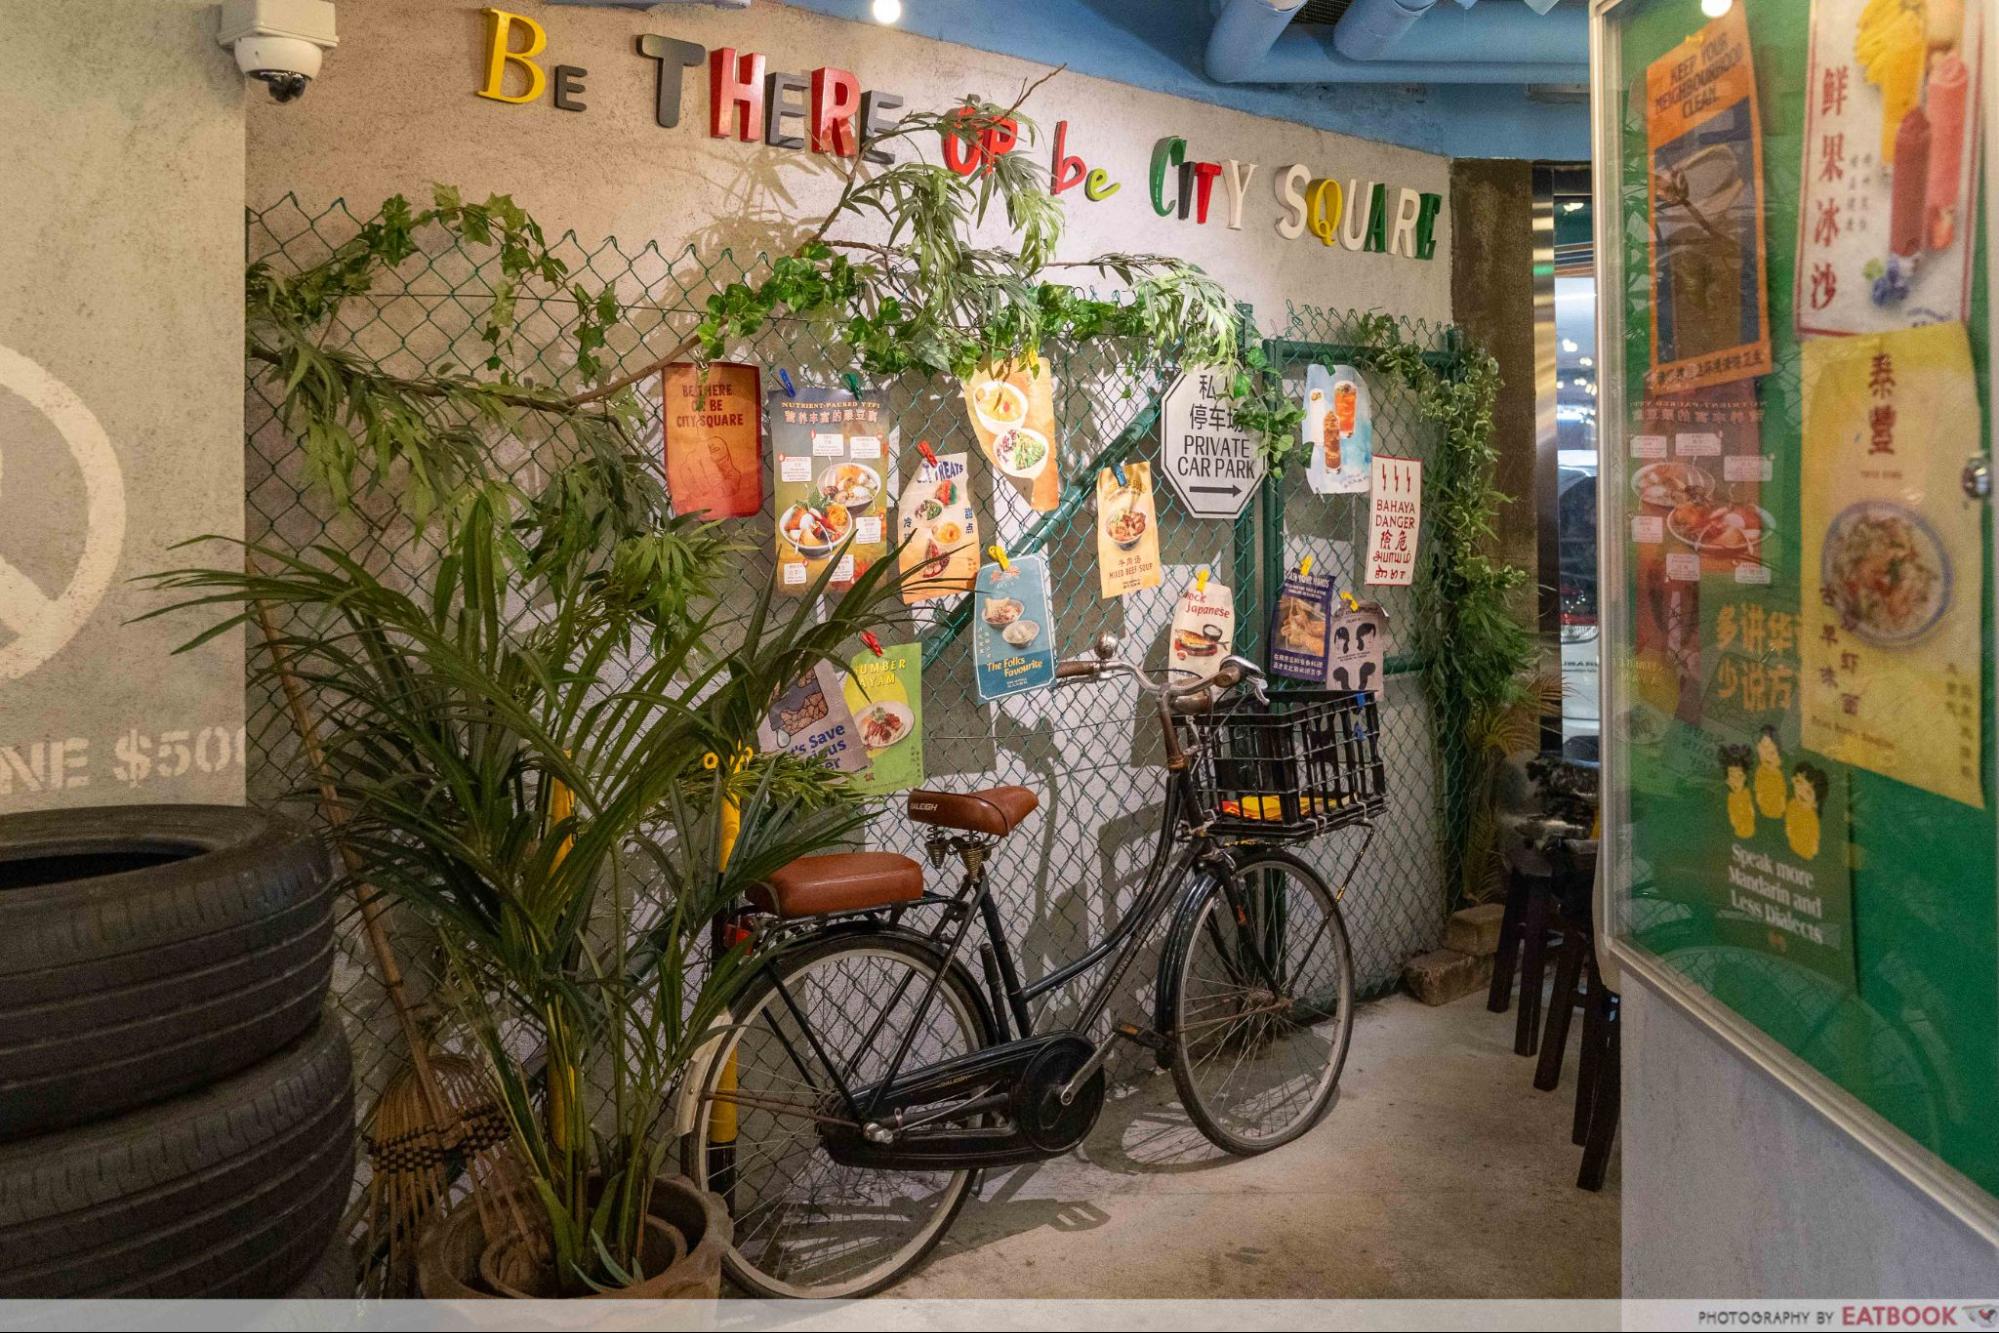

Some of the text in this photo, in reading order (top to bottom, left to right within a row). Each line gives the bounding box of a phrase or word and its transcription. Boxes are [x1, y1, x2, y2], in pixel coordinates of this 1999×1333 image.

[635, 33, 904, 165] THERE
[1049, 119, 1121, 202] be
[1149, 135, 1259, 231] CITY
[1274, 163, 1443, 261] SQUARE
[682, 383, 694, 398] BE
[710, 399, 723, 412] BE
[676, 413, 744, 428] CITY SQUARE
[1184, 434, 1250, 459] PRIVATE
[1177, 456, 1256, 480] CAR PARK
[1376, 499, 1416, 515] BAHAYA
[1375, 514, 1416, 530] DANGER
[1125, 566, 1138, 576] BEEF
[1139, 562, 1153, 574] SOUP
[1185, 602, 1231, 619] Japanese
[1716, 603, 1801, 654] 多讲华
[855, 658, 906, 676] UMBER
[987, 656, 1026, 673] The Folks
[1004, 659, 1043, 678] Favourite
[808, 723, 846, 750] Save
